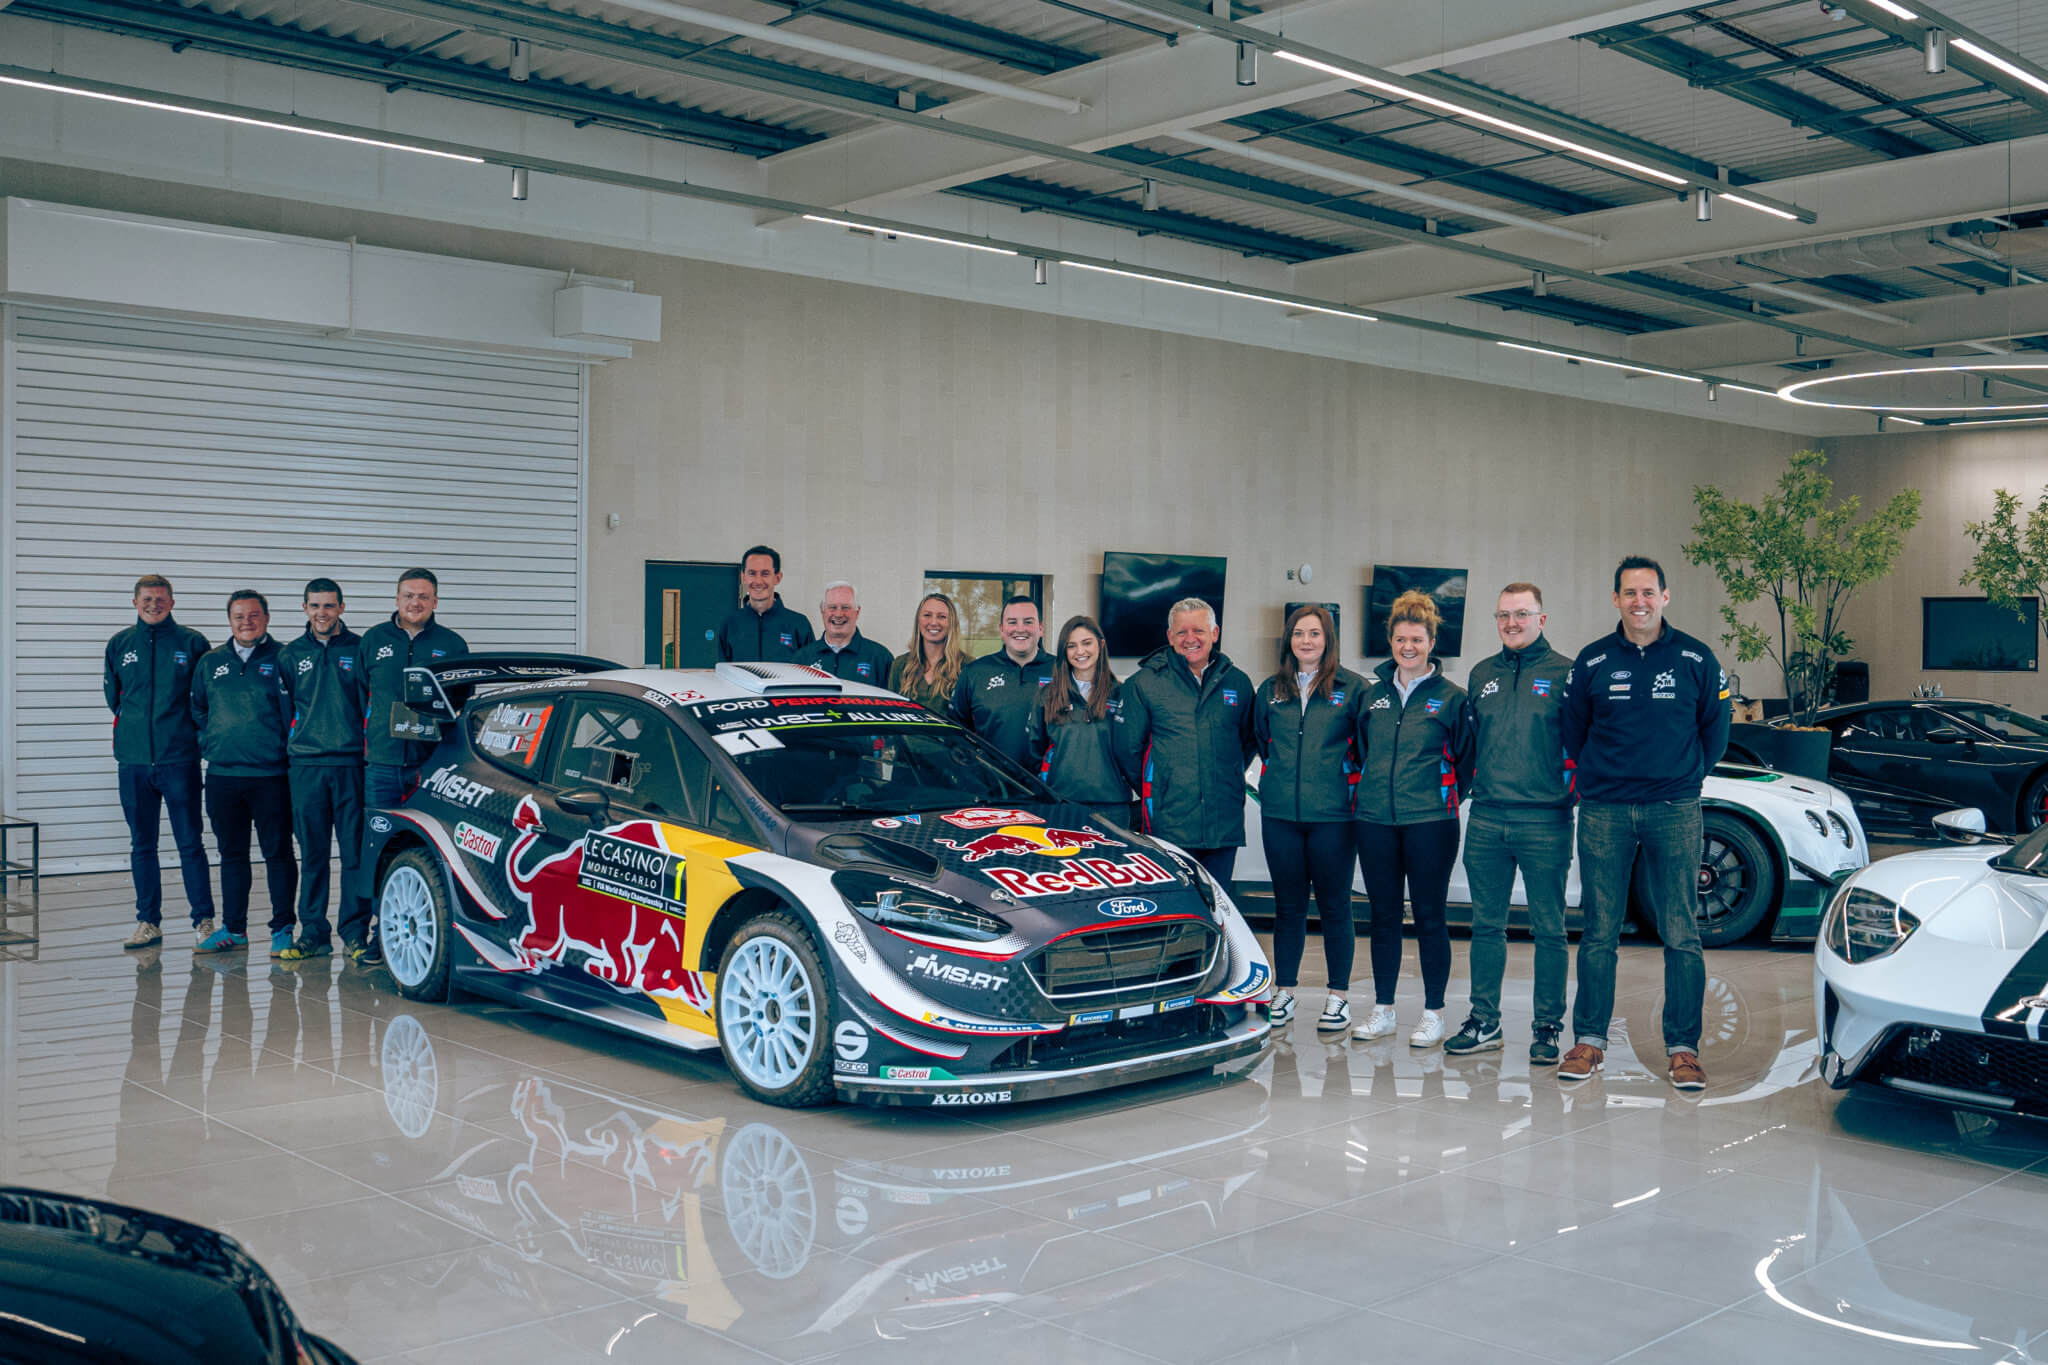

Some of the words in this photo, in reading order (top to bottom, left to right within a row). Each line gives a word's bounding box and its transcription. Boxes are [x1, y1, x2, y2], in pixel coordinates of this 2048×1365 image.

[707, 700, 769, 714] FORD
[770, 698, 925, 710] PERFORMANCE
[847, 712, 884, 721] ALL
[880, 712, 923, 722] LIVE
[738, 732, 760, 748] 1
[463, 828, 496, 859] Castrol
[585, 837, 601, 857] LE
[601, 842, 664, 876] CASINO
[674, 861, 686, 901] 1
[984, 860, 1105, 897] Red
[1082, 853, 1175, 887] Bull
[605, 883, 618, 894] World
[618, 887, 630, 899] Rally
[630, 891, 663, 909] Championship
[1110, 899, 1148, 915] Ford
[1240, 967, 1264, 993] MICHELIN
[835, 1060, 868, 1074] sparco
[897, 1069, 928, 1079] Castrol
[931, 1090, 1012, 1105] AZIONE
